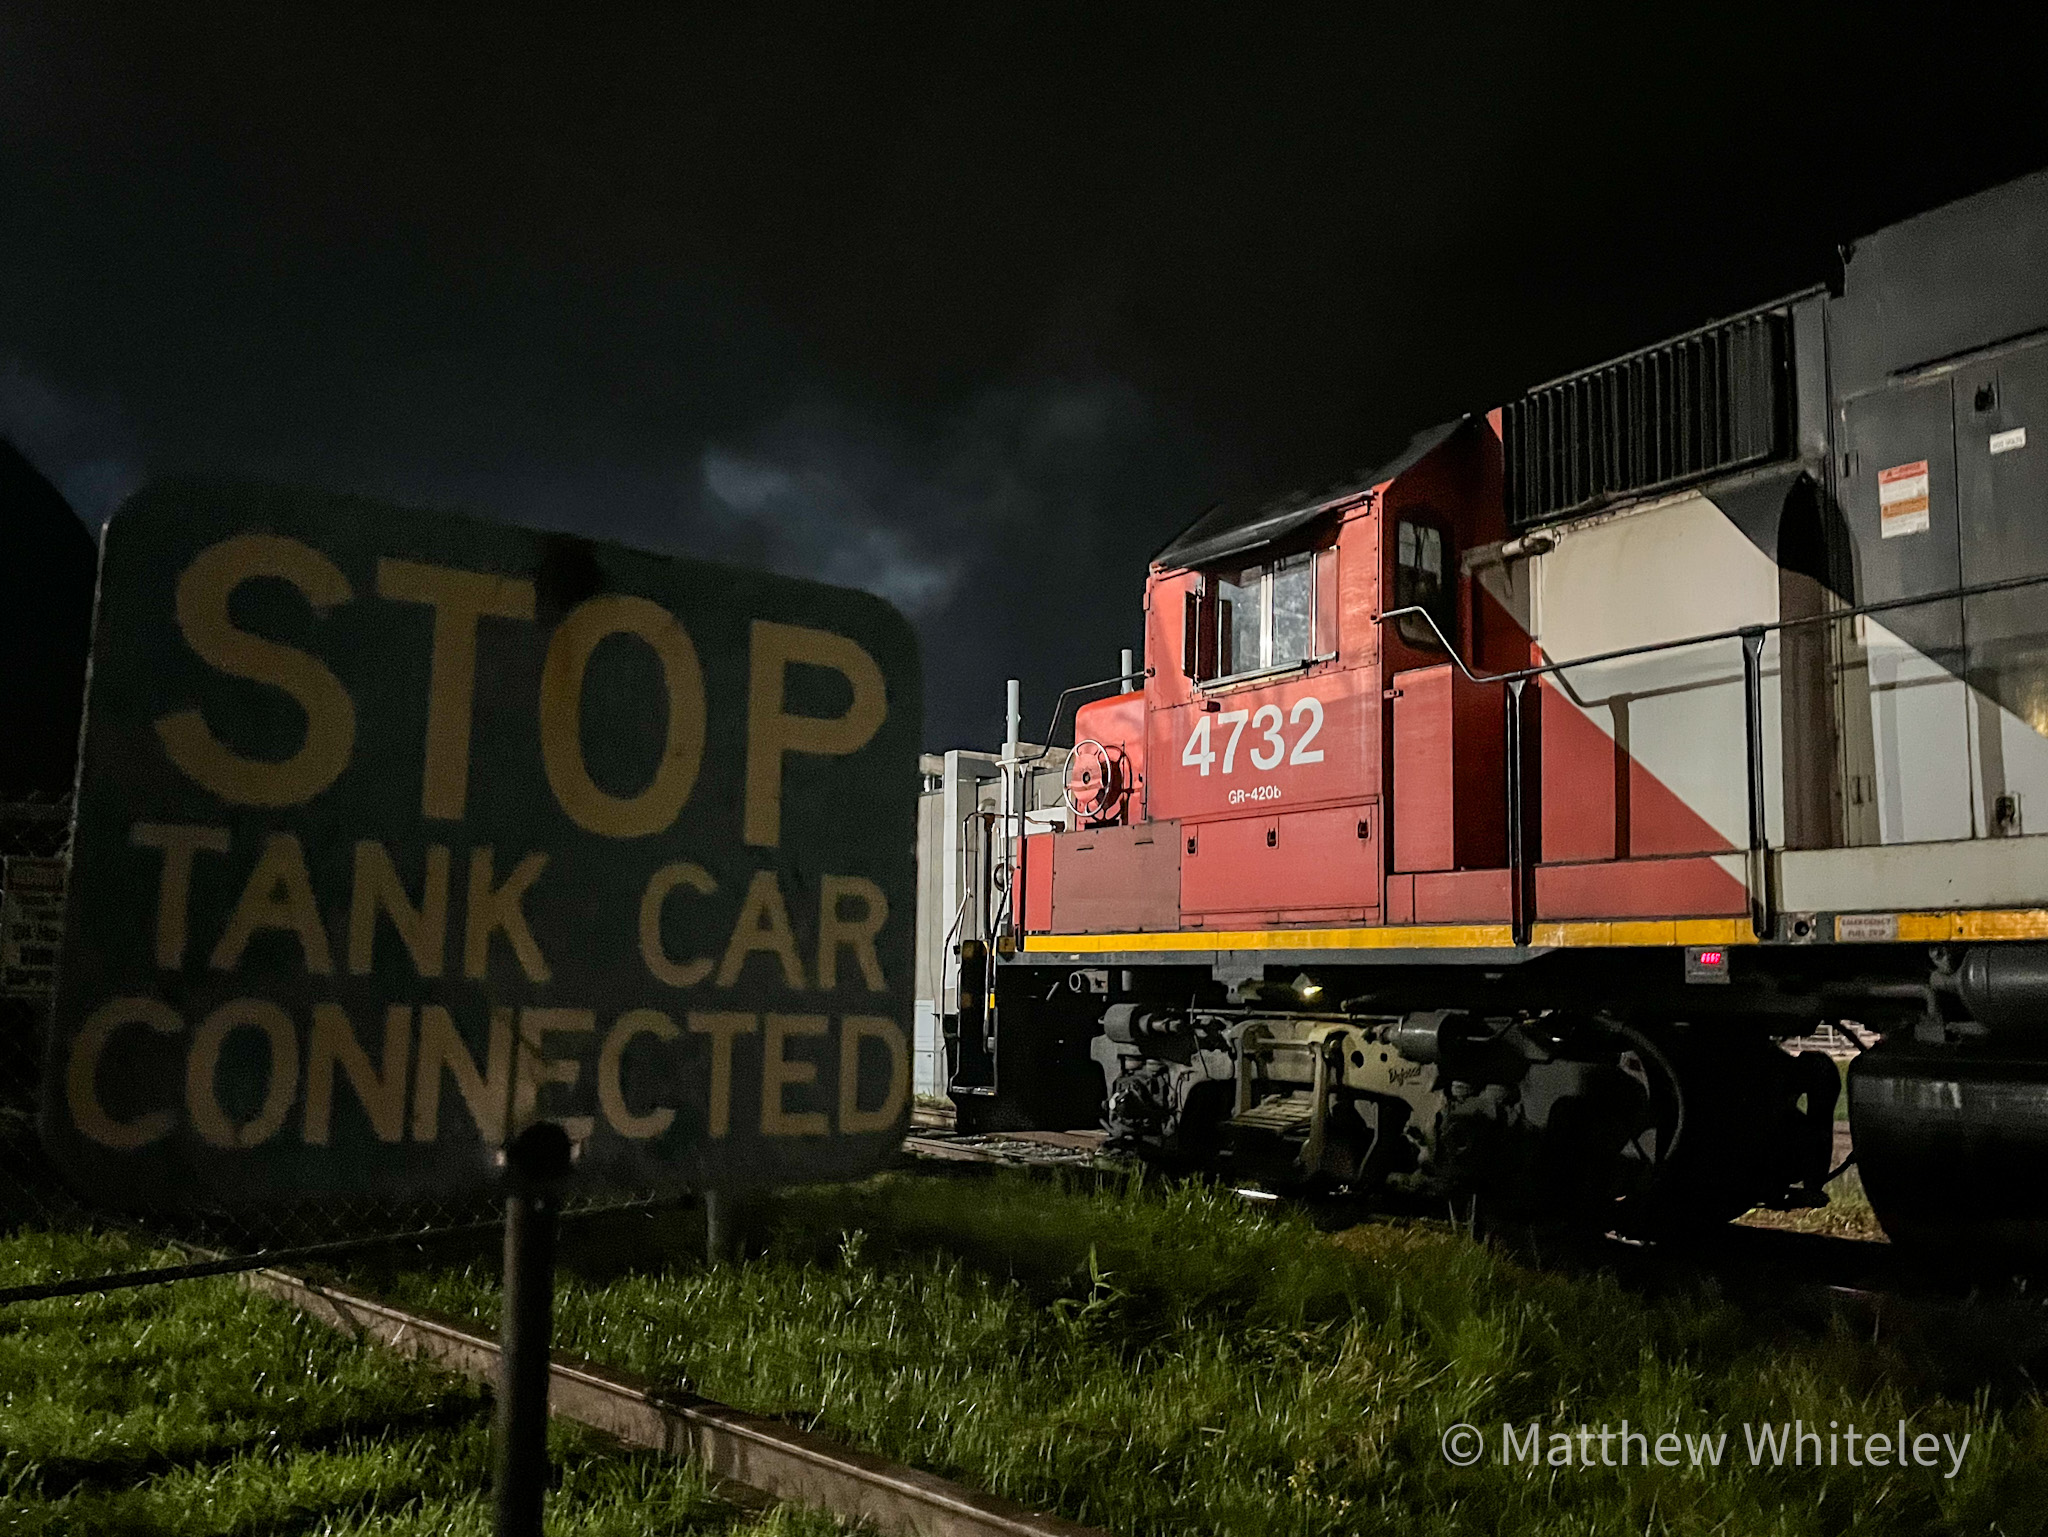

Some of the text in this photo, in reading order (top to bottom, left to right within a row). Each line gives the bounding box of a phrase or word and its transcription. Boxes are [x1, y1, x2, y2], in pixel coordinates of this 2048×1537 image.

[153, 532, 890, 848] STOP
[1181, 697, 1325, 777] 4732
[1228, 786, 1282, 805] GR-420b
[130, 820, 890, 993] TANK CAR
[66, 996, 910, 1151] CONNECTED
